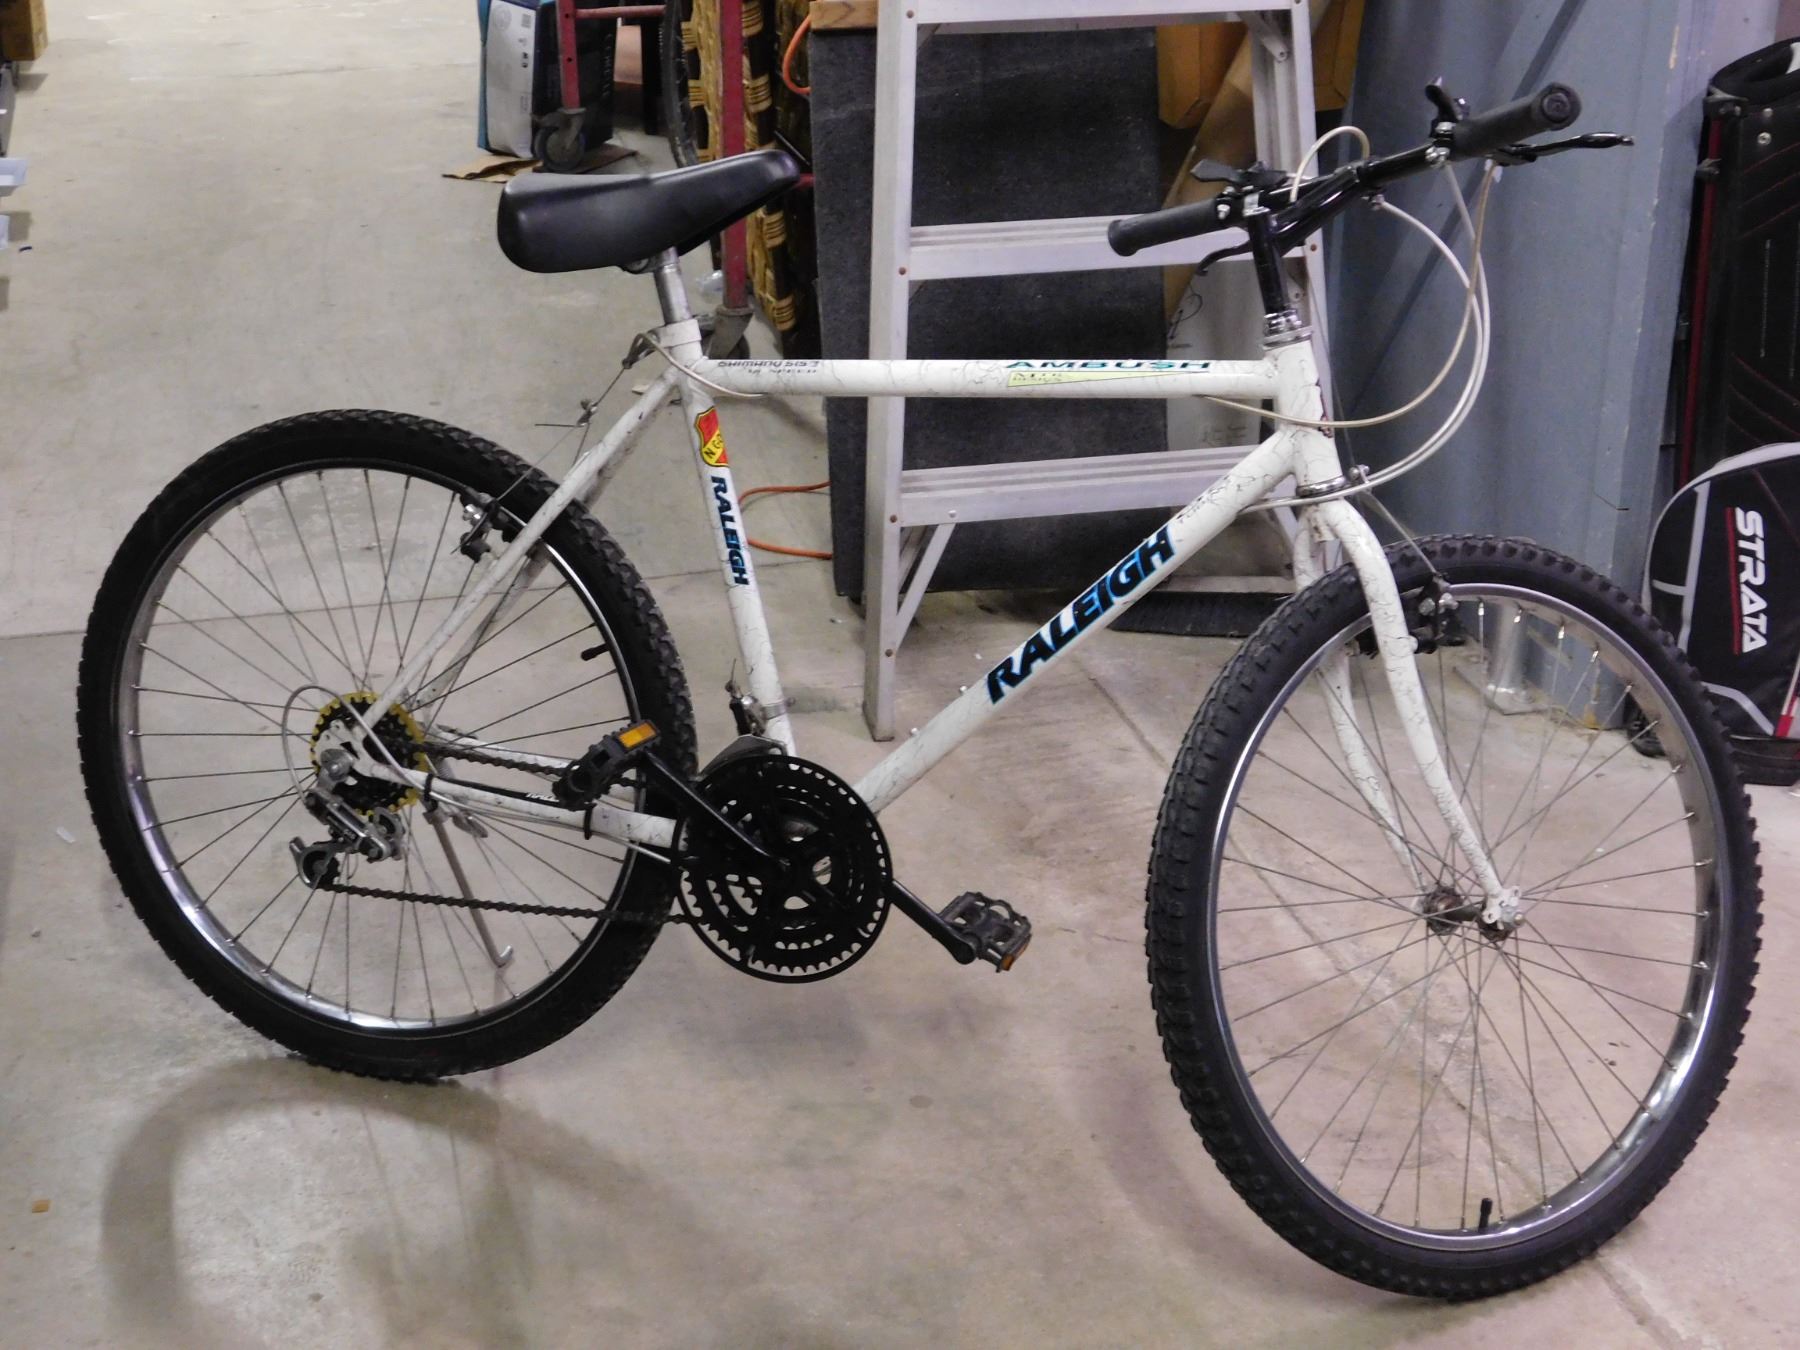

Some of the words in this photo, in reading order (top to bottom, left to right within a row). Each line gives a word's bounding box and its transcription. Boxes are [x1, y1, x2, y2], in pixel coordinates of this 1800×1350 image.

[1005, 361, 1211, 370] AMBUSH
[710, 475, 750, 586] RALEIGH
[1734, 506, 1768, 654] STRATA
[987, 523, 1176, 706] RALEIGH
